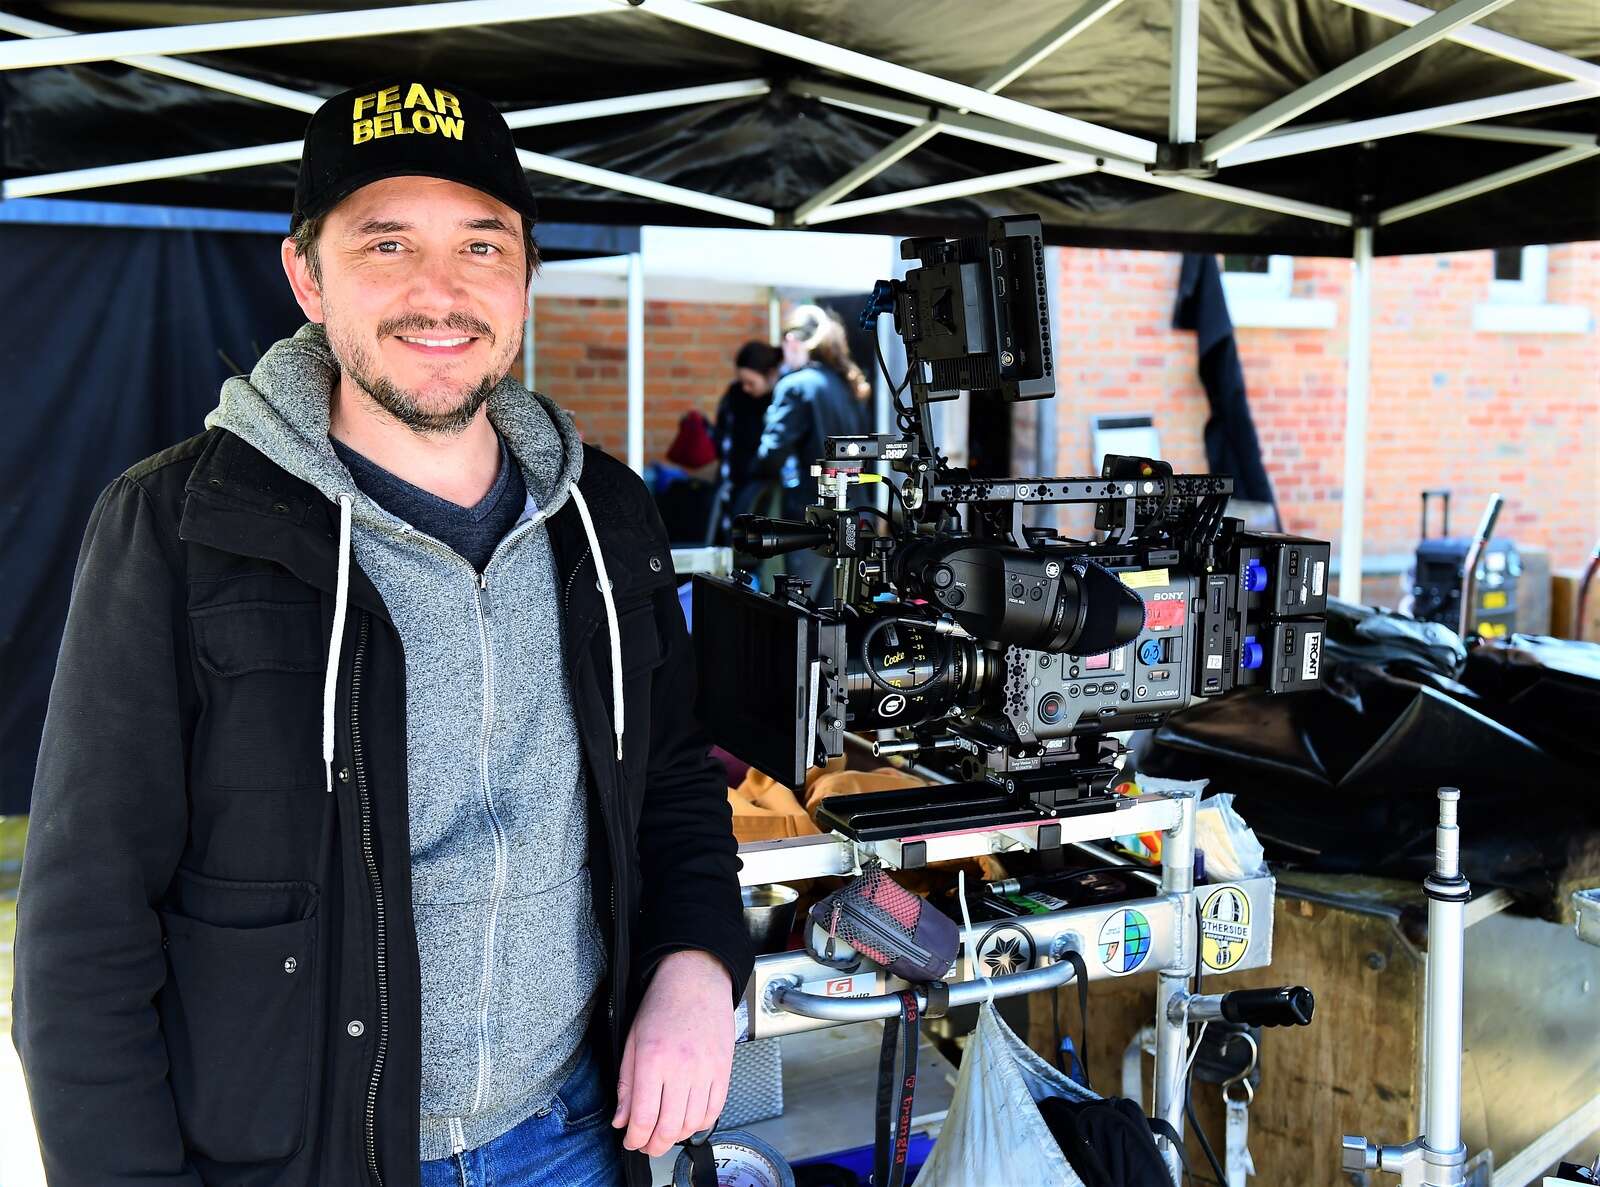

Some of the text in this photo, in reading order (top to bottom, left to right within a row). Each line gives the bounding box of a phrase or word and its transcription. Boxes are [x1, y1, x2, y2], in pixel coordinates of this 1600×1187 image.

[353, 83, 462, 120] FEAR
[353, 110, 464, 145] BELOW
[845, 523, 856, 551] ARRI
[1153, 592, 1184, 600] SONY
[884, 651, 905, 667] Cooke
[1143, 645, 1160, 660] 0.3
[1310, 635, 1319, 676] FRONT
[1202, 921, 1248, 937] OTHERSIDE
[896, 1096, 913, 1164] trangia
